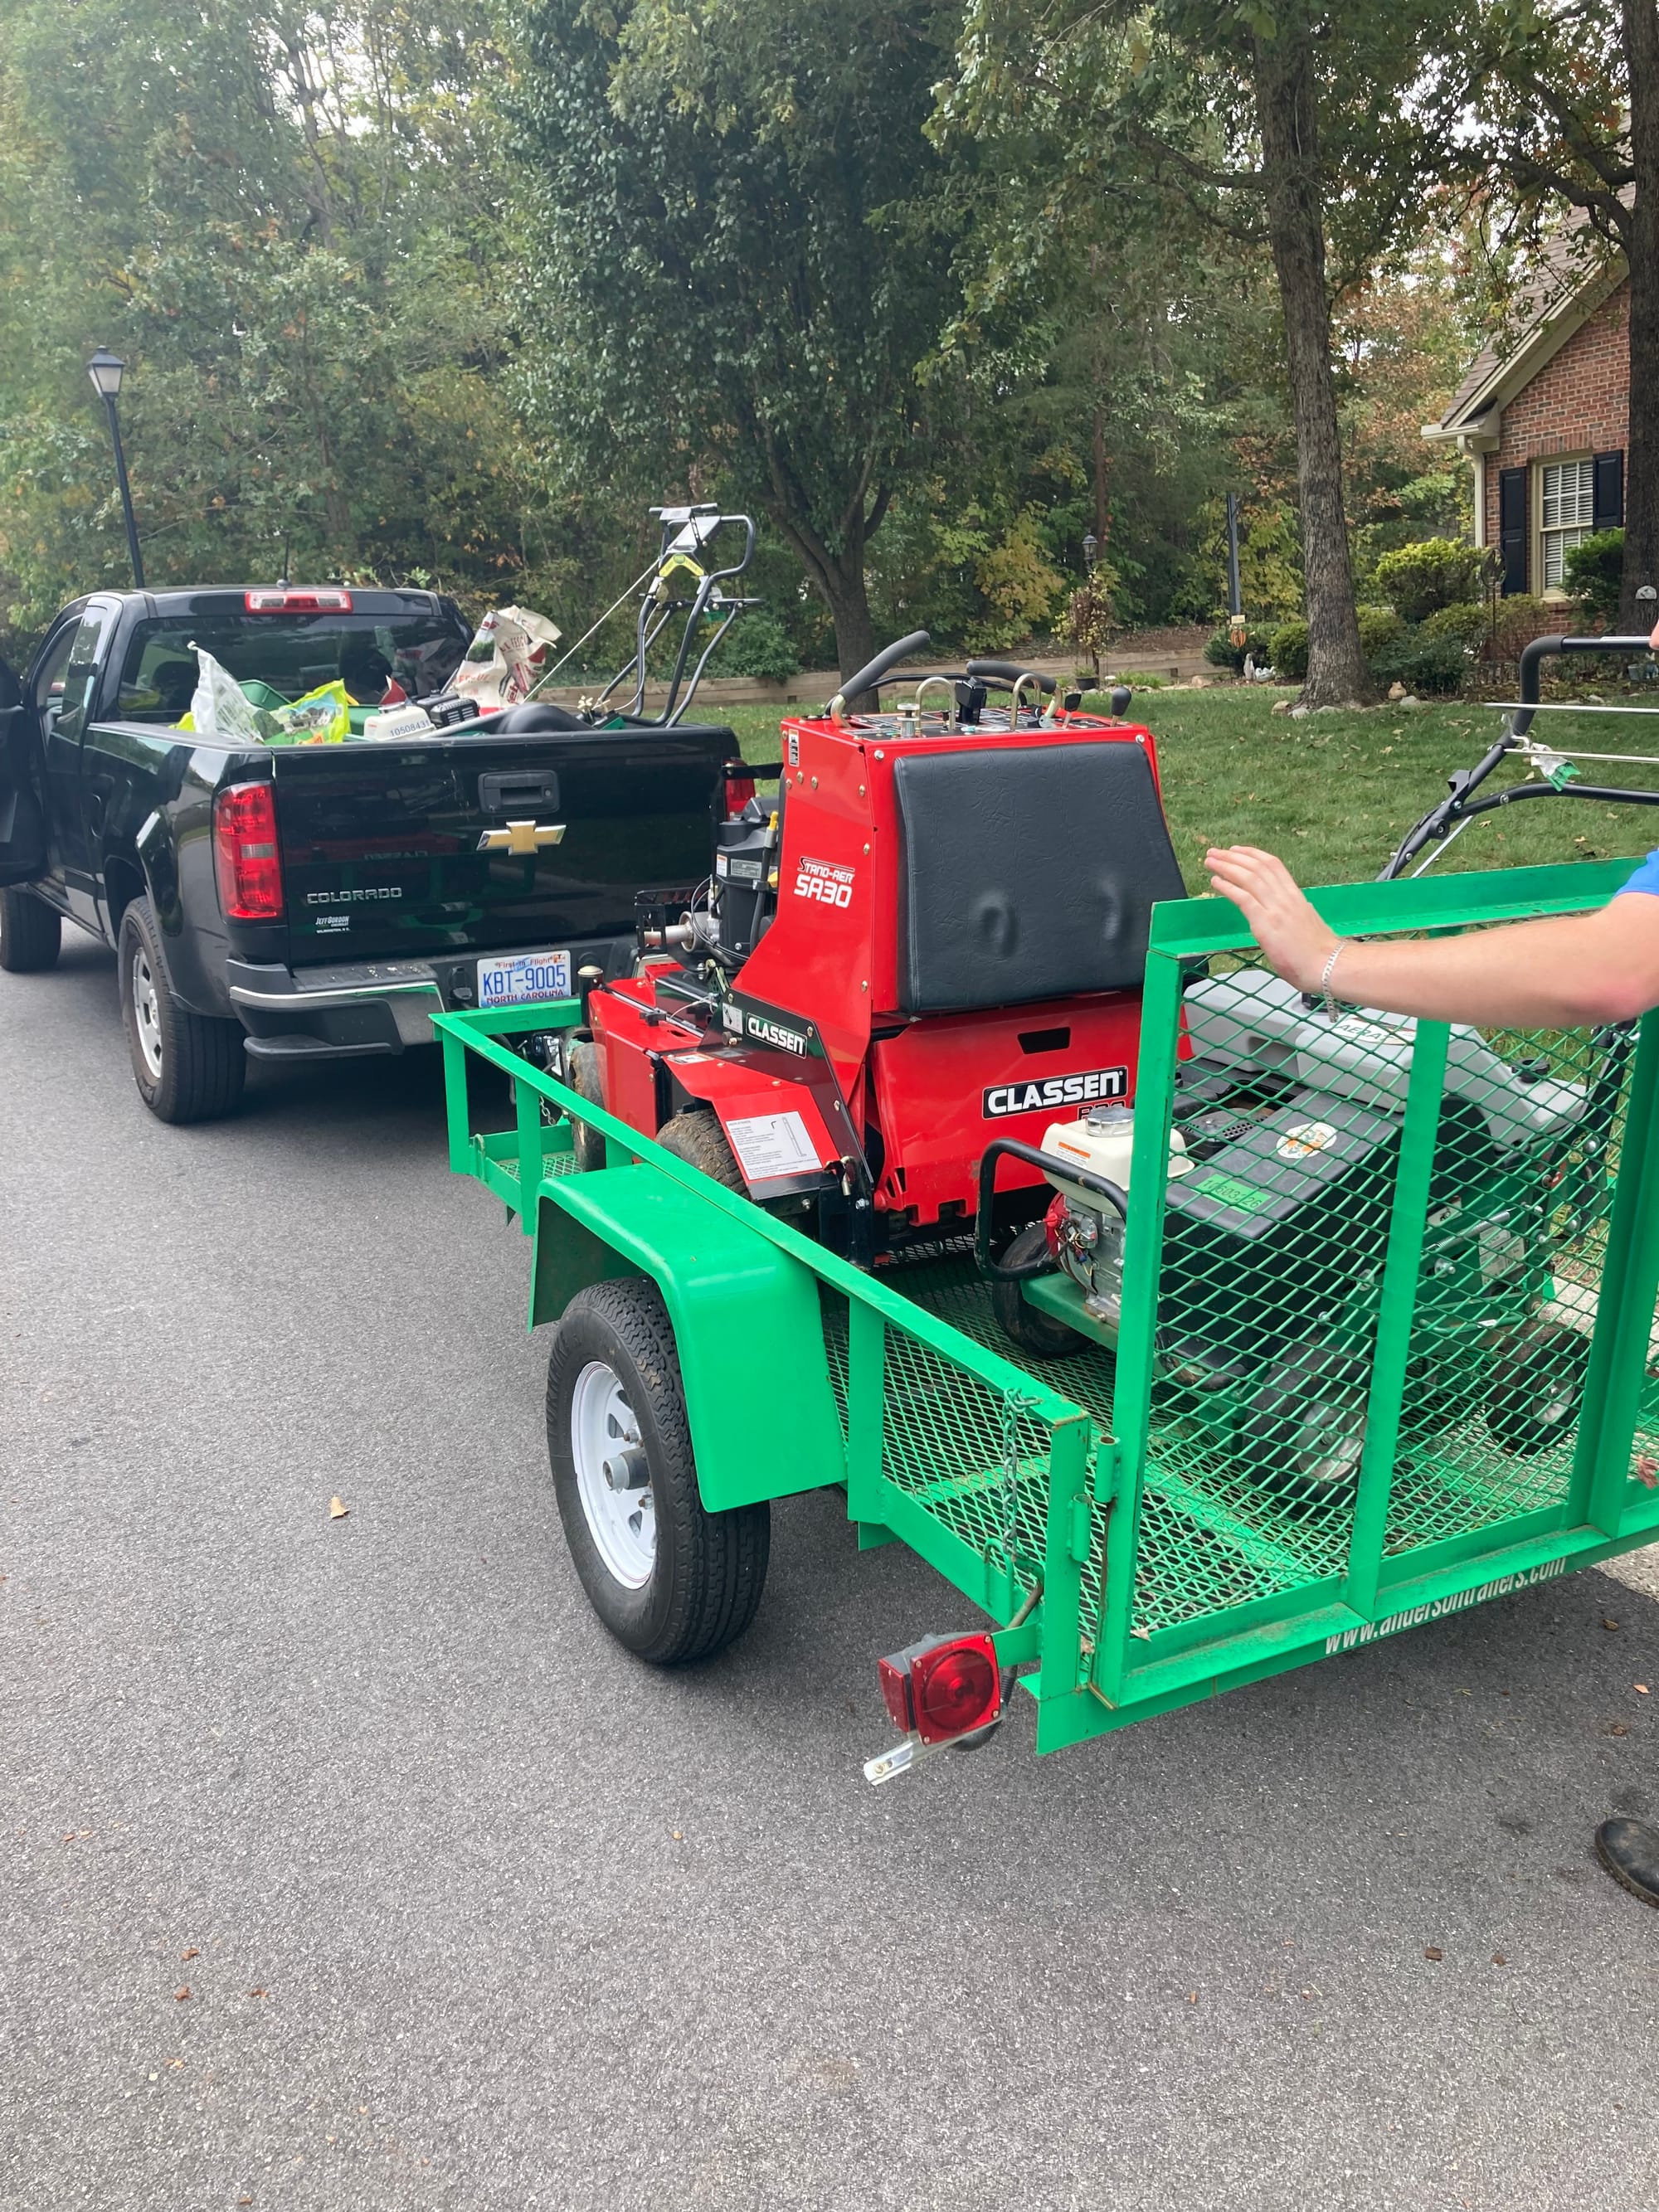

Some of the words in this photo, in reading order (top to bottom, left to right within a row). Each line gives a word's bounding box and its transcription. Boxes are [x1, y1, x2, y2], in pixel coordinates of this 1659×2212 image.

[390, 720, 430, 737] 10508431
[307, 887, 402, 904] COLORADO
[794, 873, 852, 908] SA30
[484, 965, 566, 995] KBT-9005
[487, 994, 518, 1004] NORTH
[521, 989, 564, 1000] CAROLINA
[748, 1017, 805, 1054] CLASSEN
[988, 1071, 1123, 1114] CLASSEN
